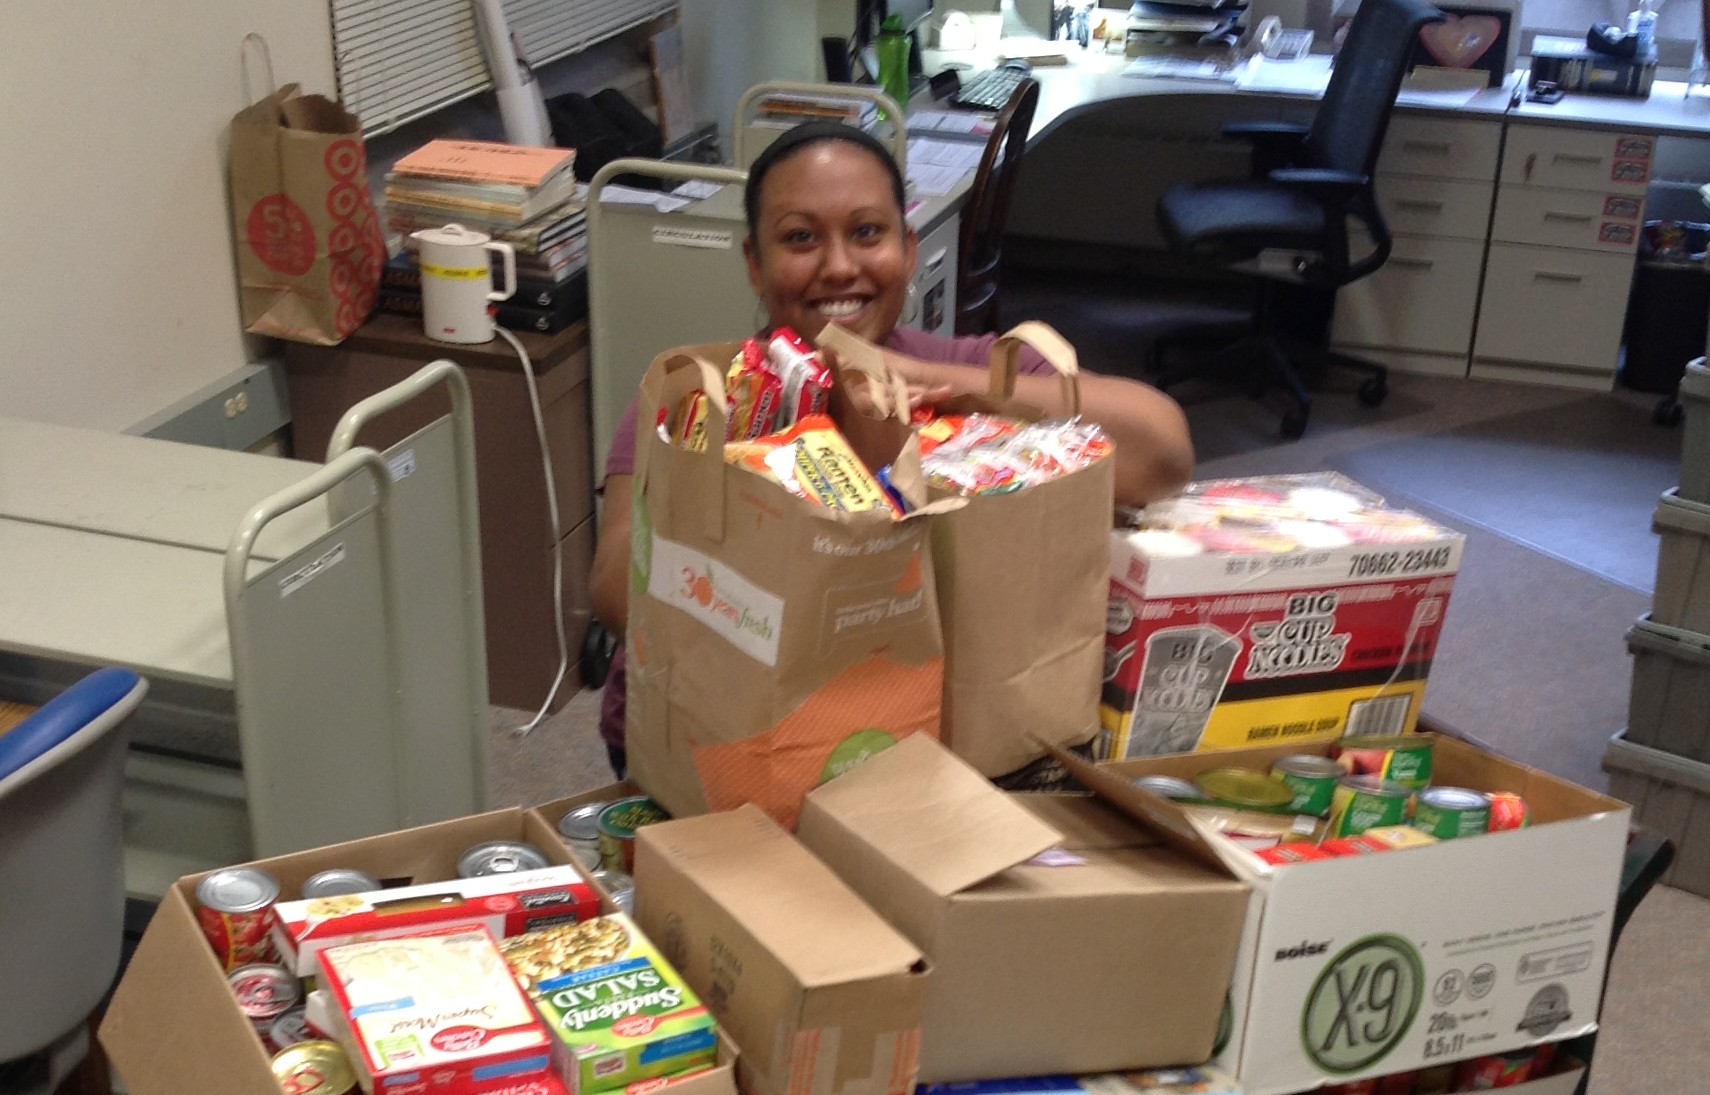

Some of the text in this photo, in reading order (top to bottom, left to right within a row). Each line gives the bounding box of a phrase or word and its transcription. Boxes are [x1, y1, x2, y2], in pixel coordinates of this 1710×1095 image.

[816, 446, 865, 505] Ramen
[1348, 546, 1450, 578] 70662-23443
[1288, 593, 1336, 616] BIG
[1278, 617, 1333, 646] CUP
[551, 969, 661, 1009] SALAD
[561, 986, 685, 1031] Suddenly
